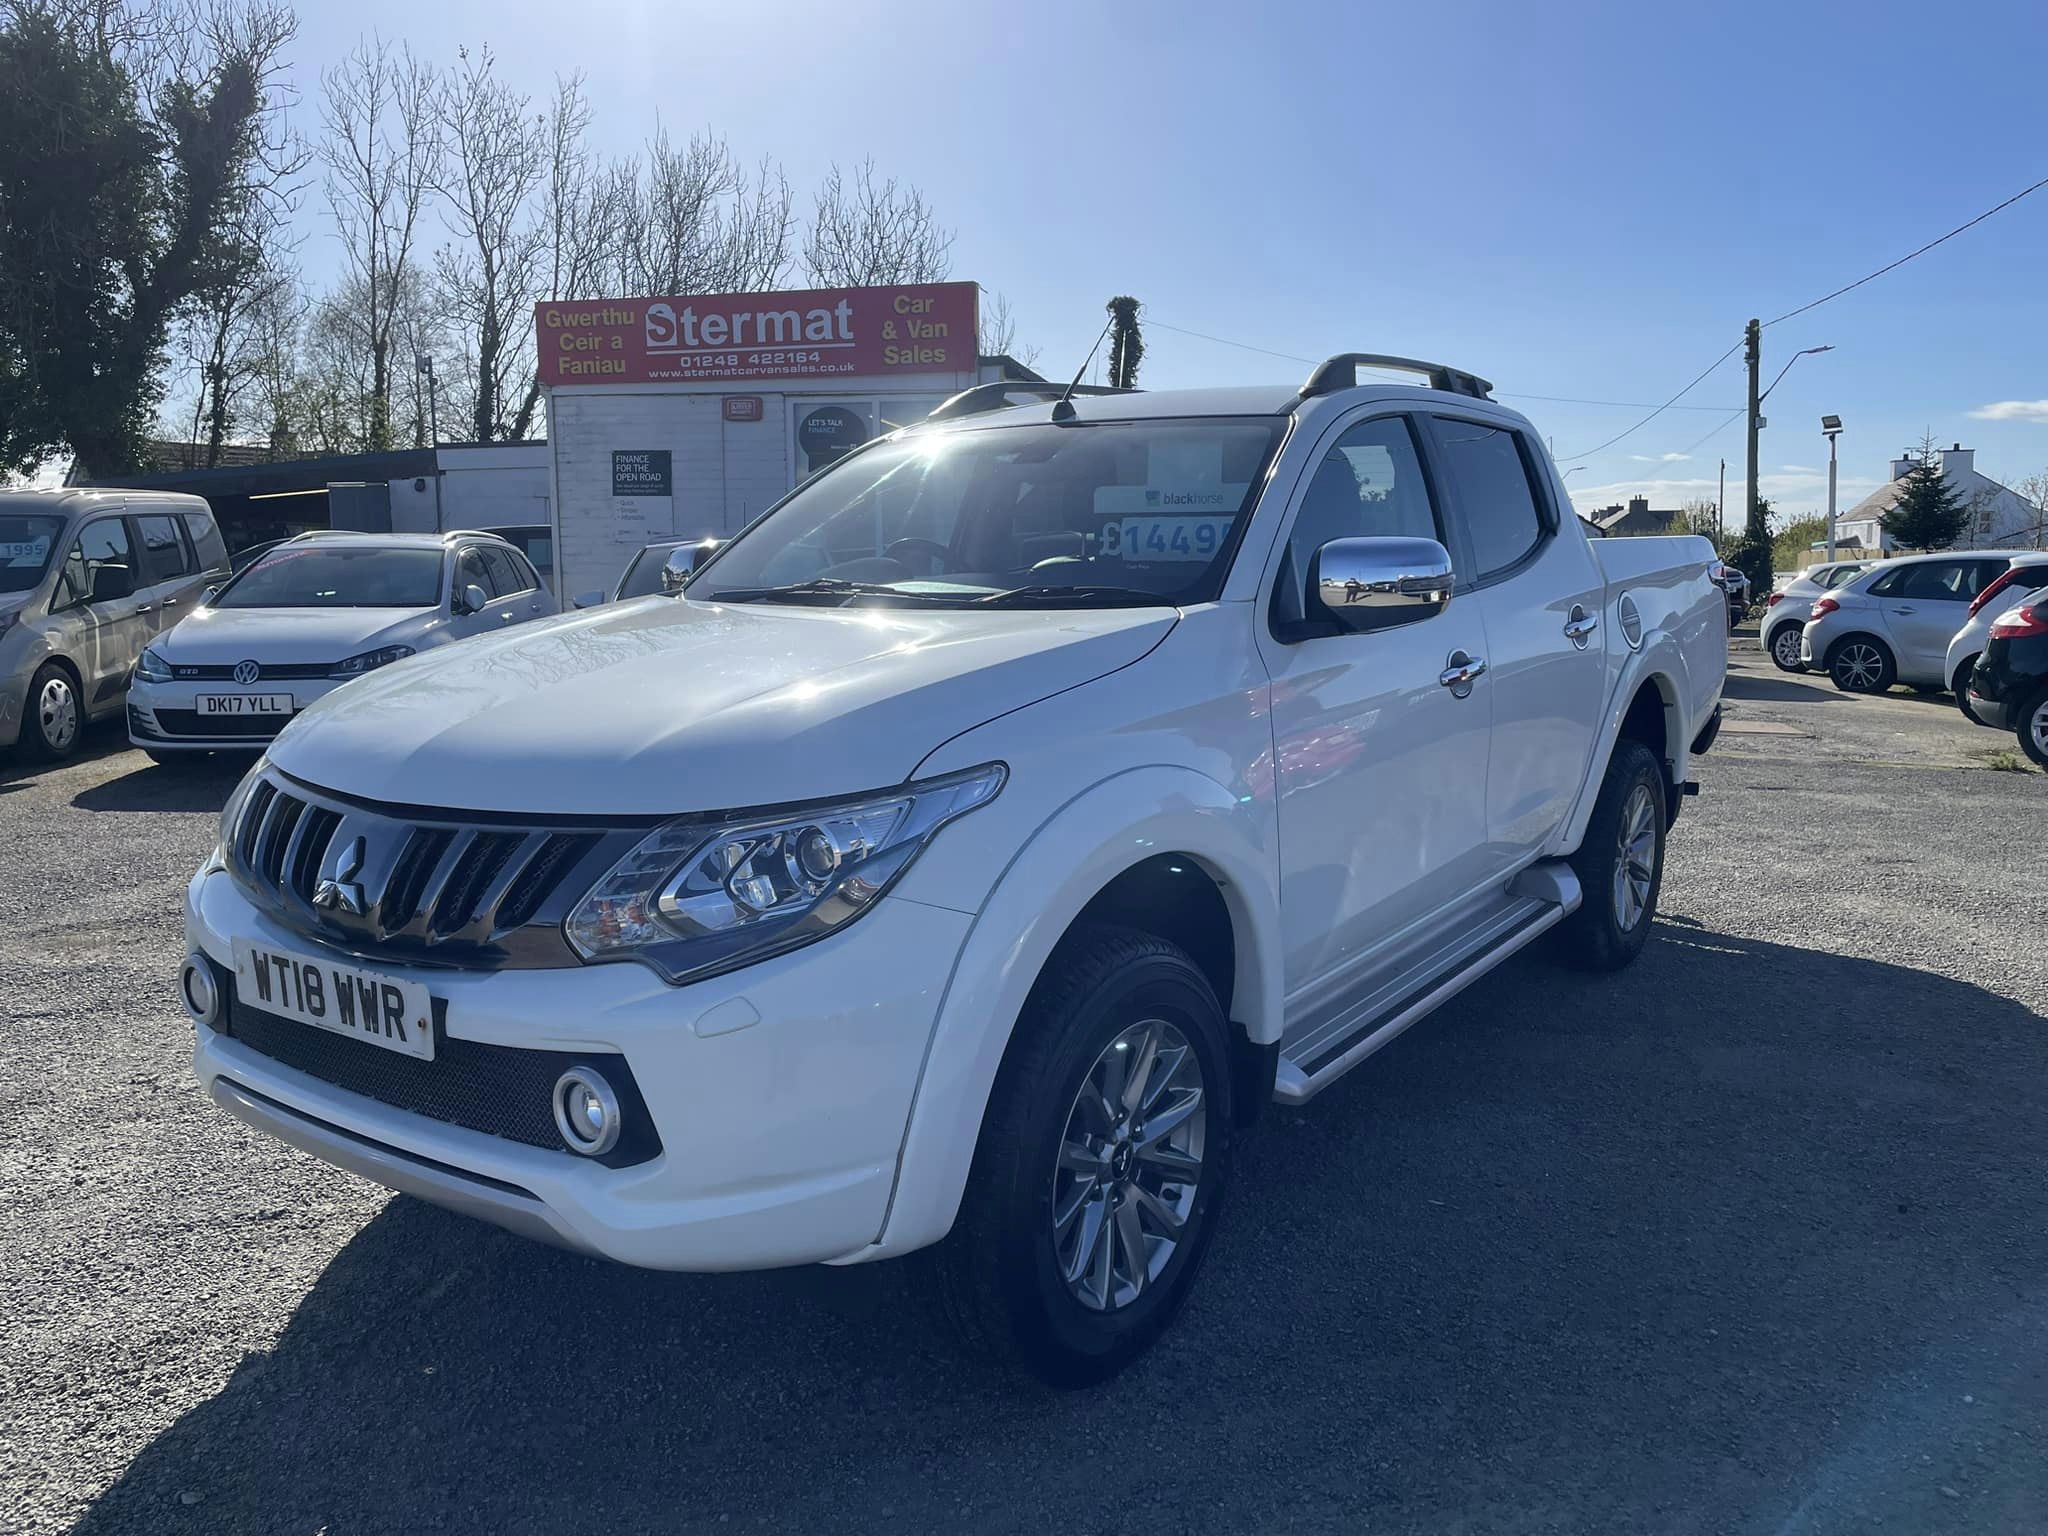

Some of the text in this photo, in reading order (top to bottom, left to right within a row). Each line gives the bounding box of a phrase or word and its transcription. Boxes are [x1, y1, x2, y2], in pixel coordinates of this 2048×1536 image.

[893, 295, 935, 314] Car
[545, 308, 635, 328] Gwerthu
[646, 298, 854, 347] Stermat
[882, 319, 948, 340] & Van
[559, 332, 623, 352] Ceir a
[680, 352, 820, 368] 01248 422164
[883, 344, 946, 365] Sales
[558, 355, 626, 374] Faniau
[649, 362, 855, 378] www.stermatcarvansales.co.uk
[827, 420, 843, 428] TALK
[616, 455, 650, 464] FINANCE
[616, 463, 650, 473] FOR THE
[616, 472, 662, 482] OPEN ROAD
[1163, 493, 1224, 505] blackhorse
[207, 697, 281, 713] DK17 YLL
[251, 949, 408, 1043] WT18 WWR
